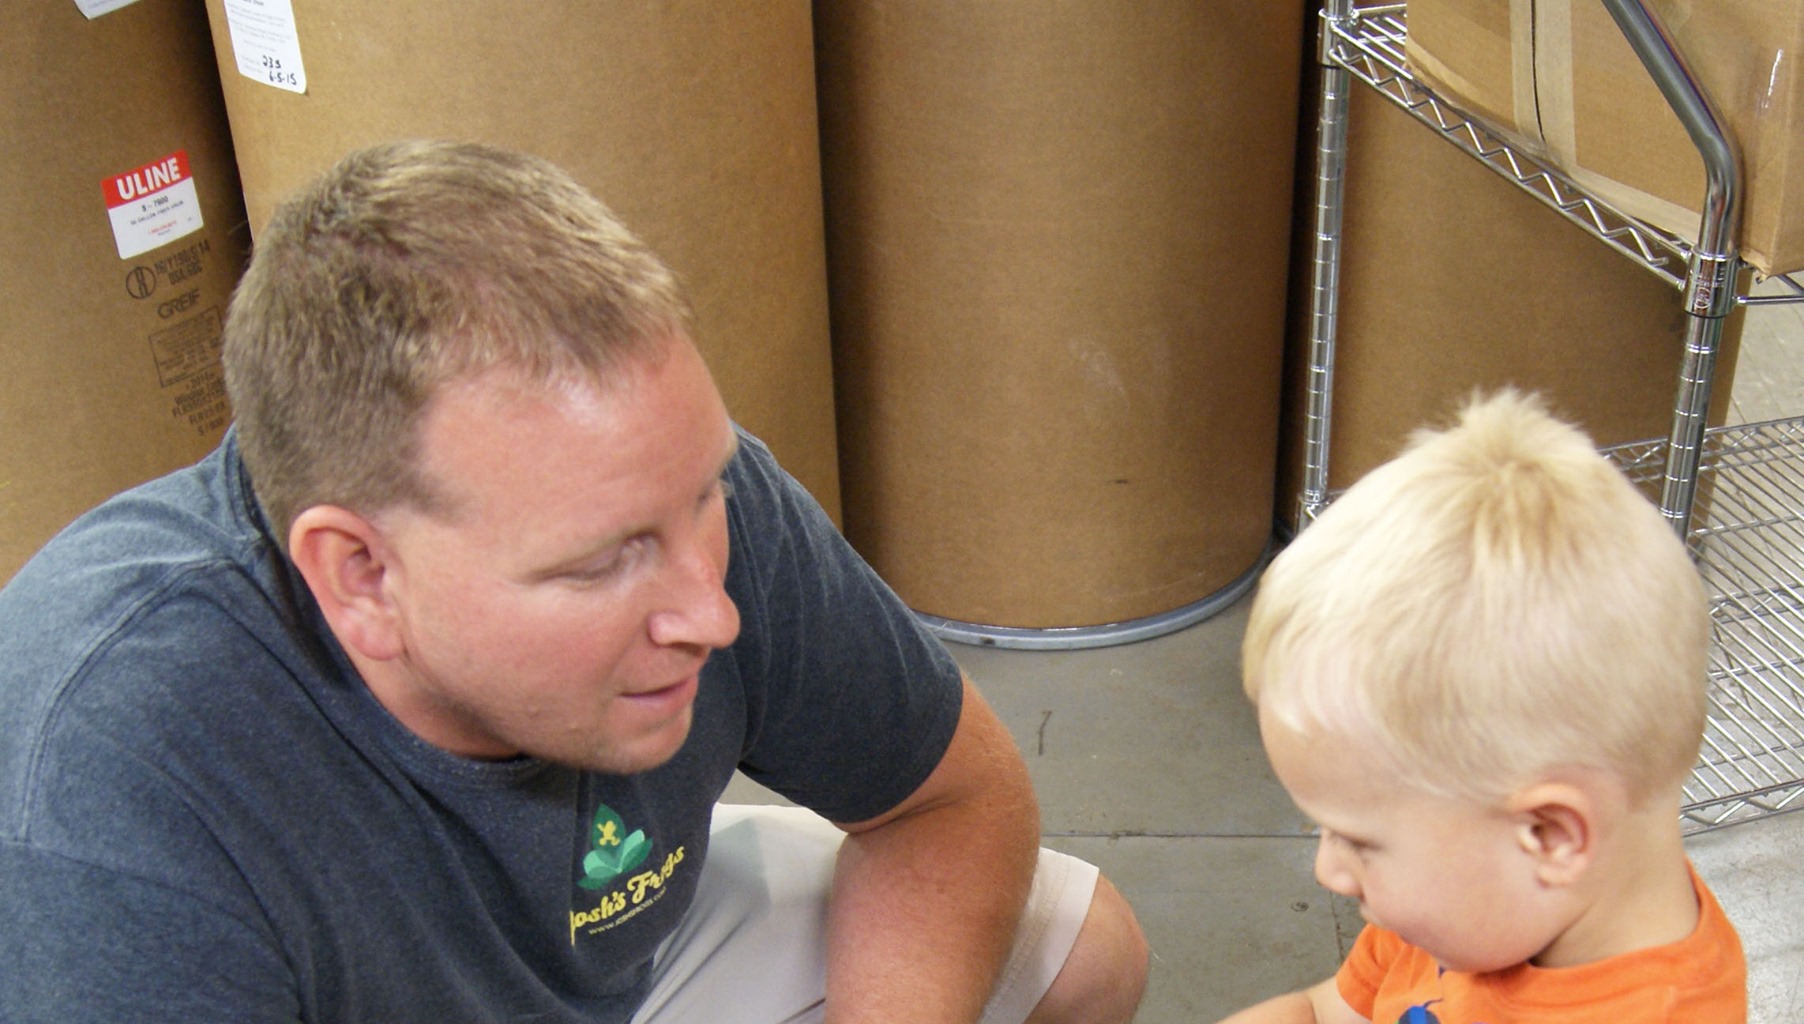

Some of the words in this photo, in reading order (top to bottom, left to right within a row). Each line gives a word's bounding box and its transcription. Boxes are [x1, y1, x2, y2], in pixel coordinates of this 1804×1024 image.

[116, 157, 181, 200] ULINE
[157, 288, 201, 320] GREIF
[626, 846, 685, 904] Frogs
